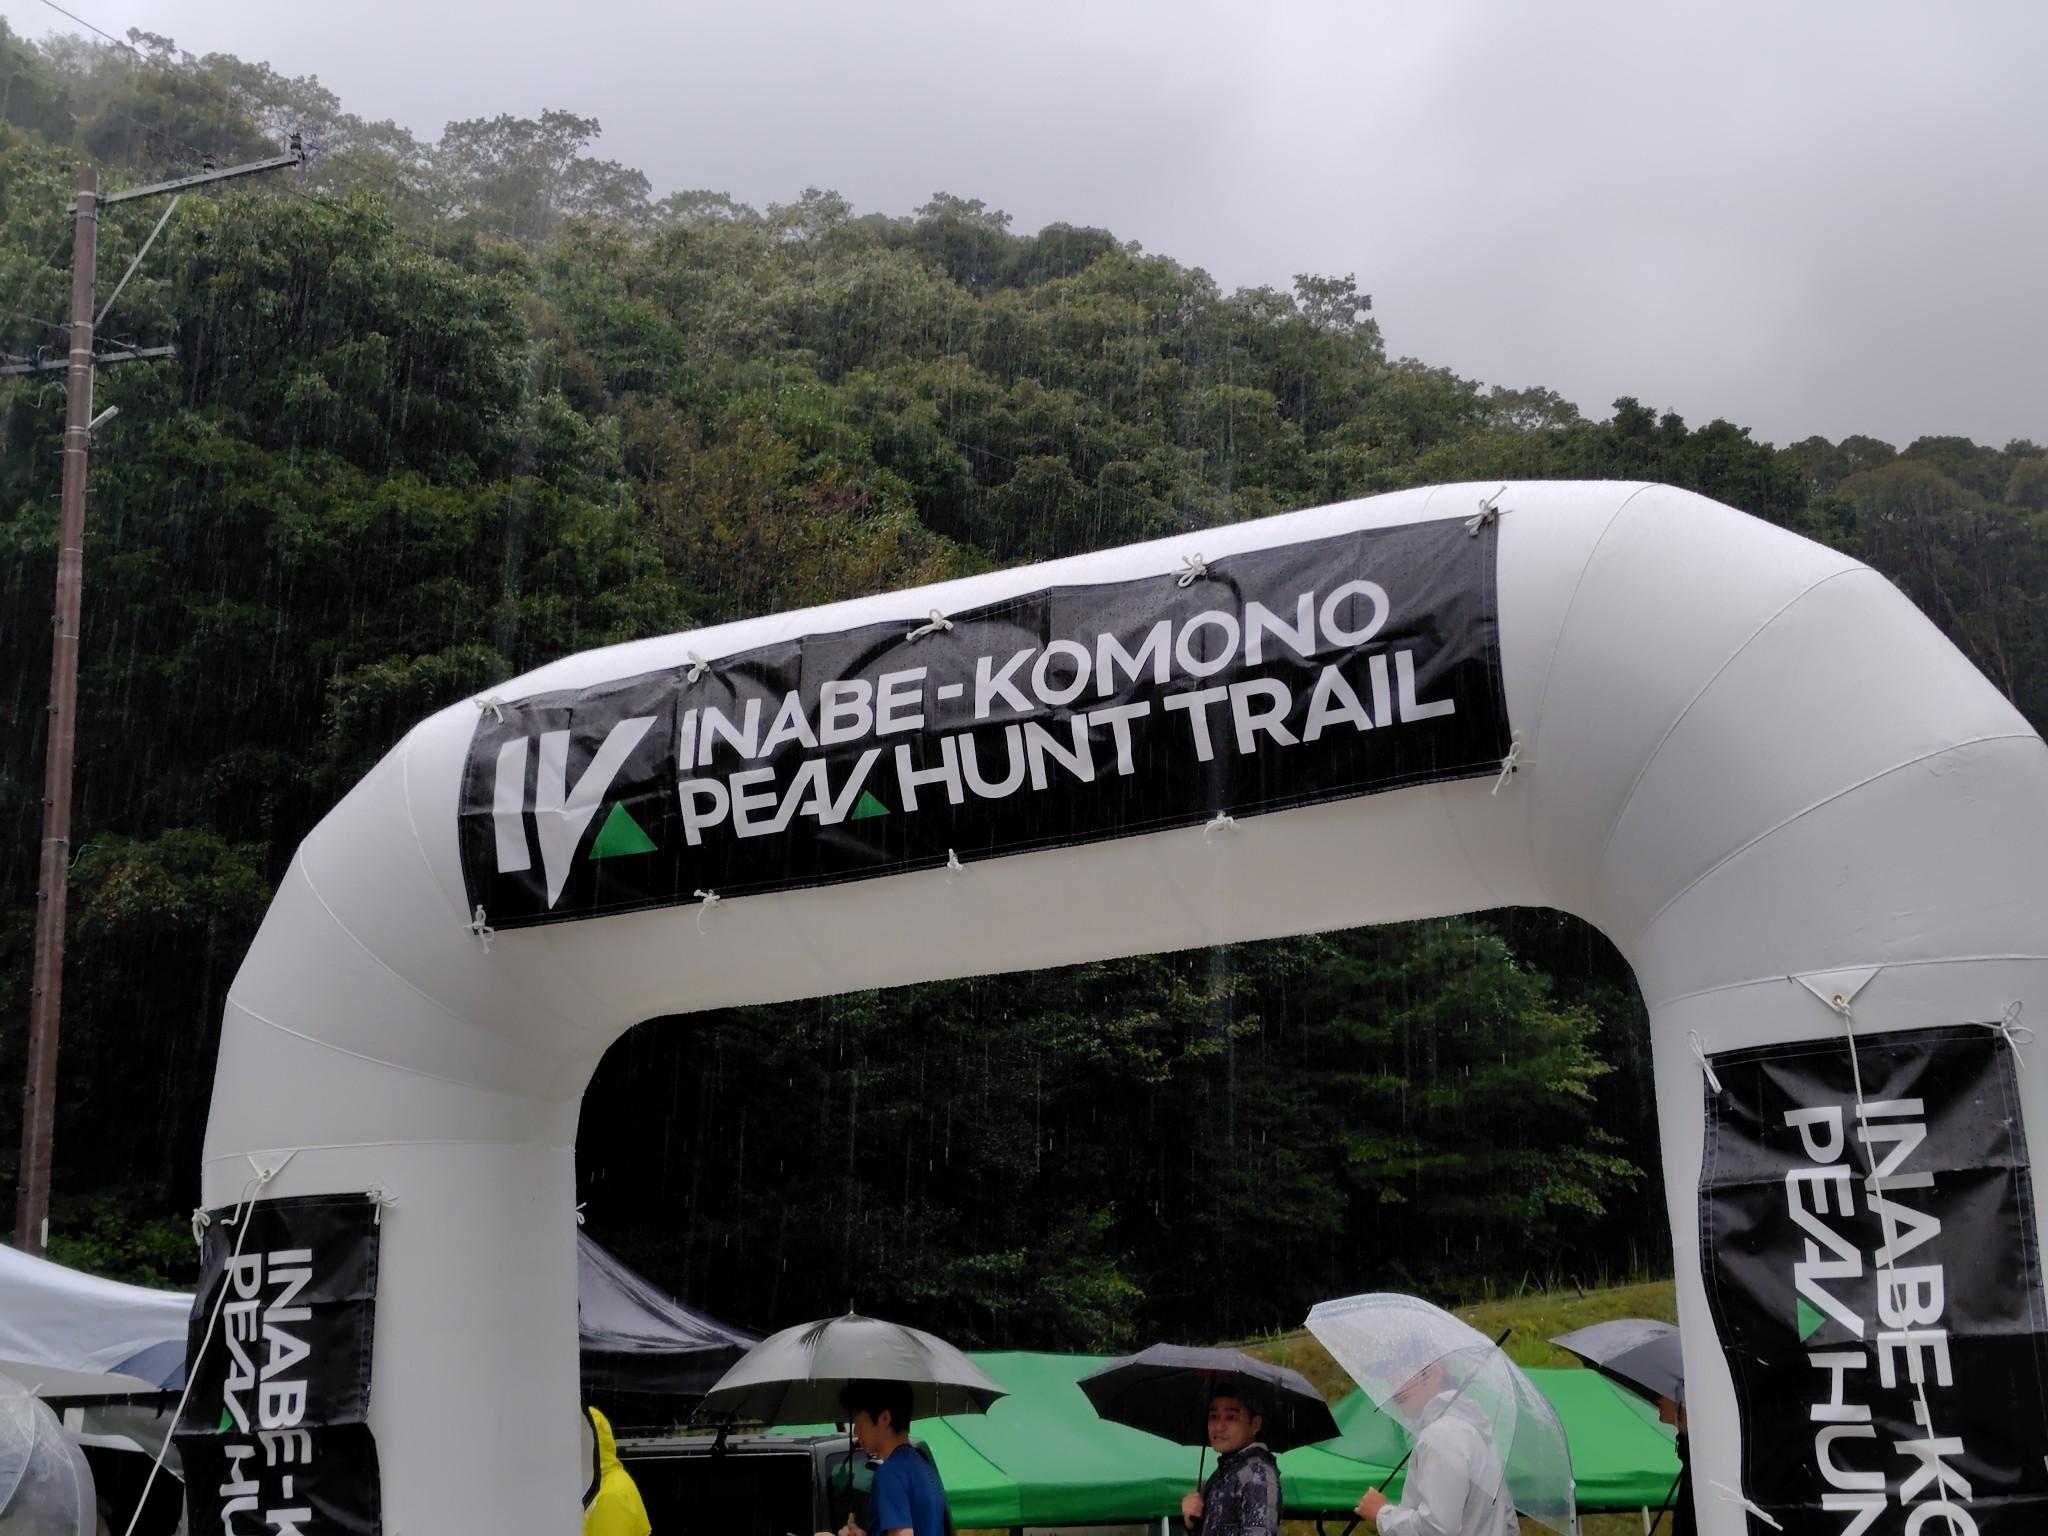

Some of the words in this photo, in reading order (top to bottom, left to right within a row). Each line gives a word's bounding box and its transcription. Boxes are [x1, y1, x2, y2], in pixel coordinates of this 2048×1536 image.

[679, 579, 1390, 770] INABE-KOMONO
[895, 701, 1151, 812] HUNT
[1164, 650, 1456, 762] TRAIL
